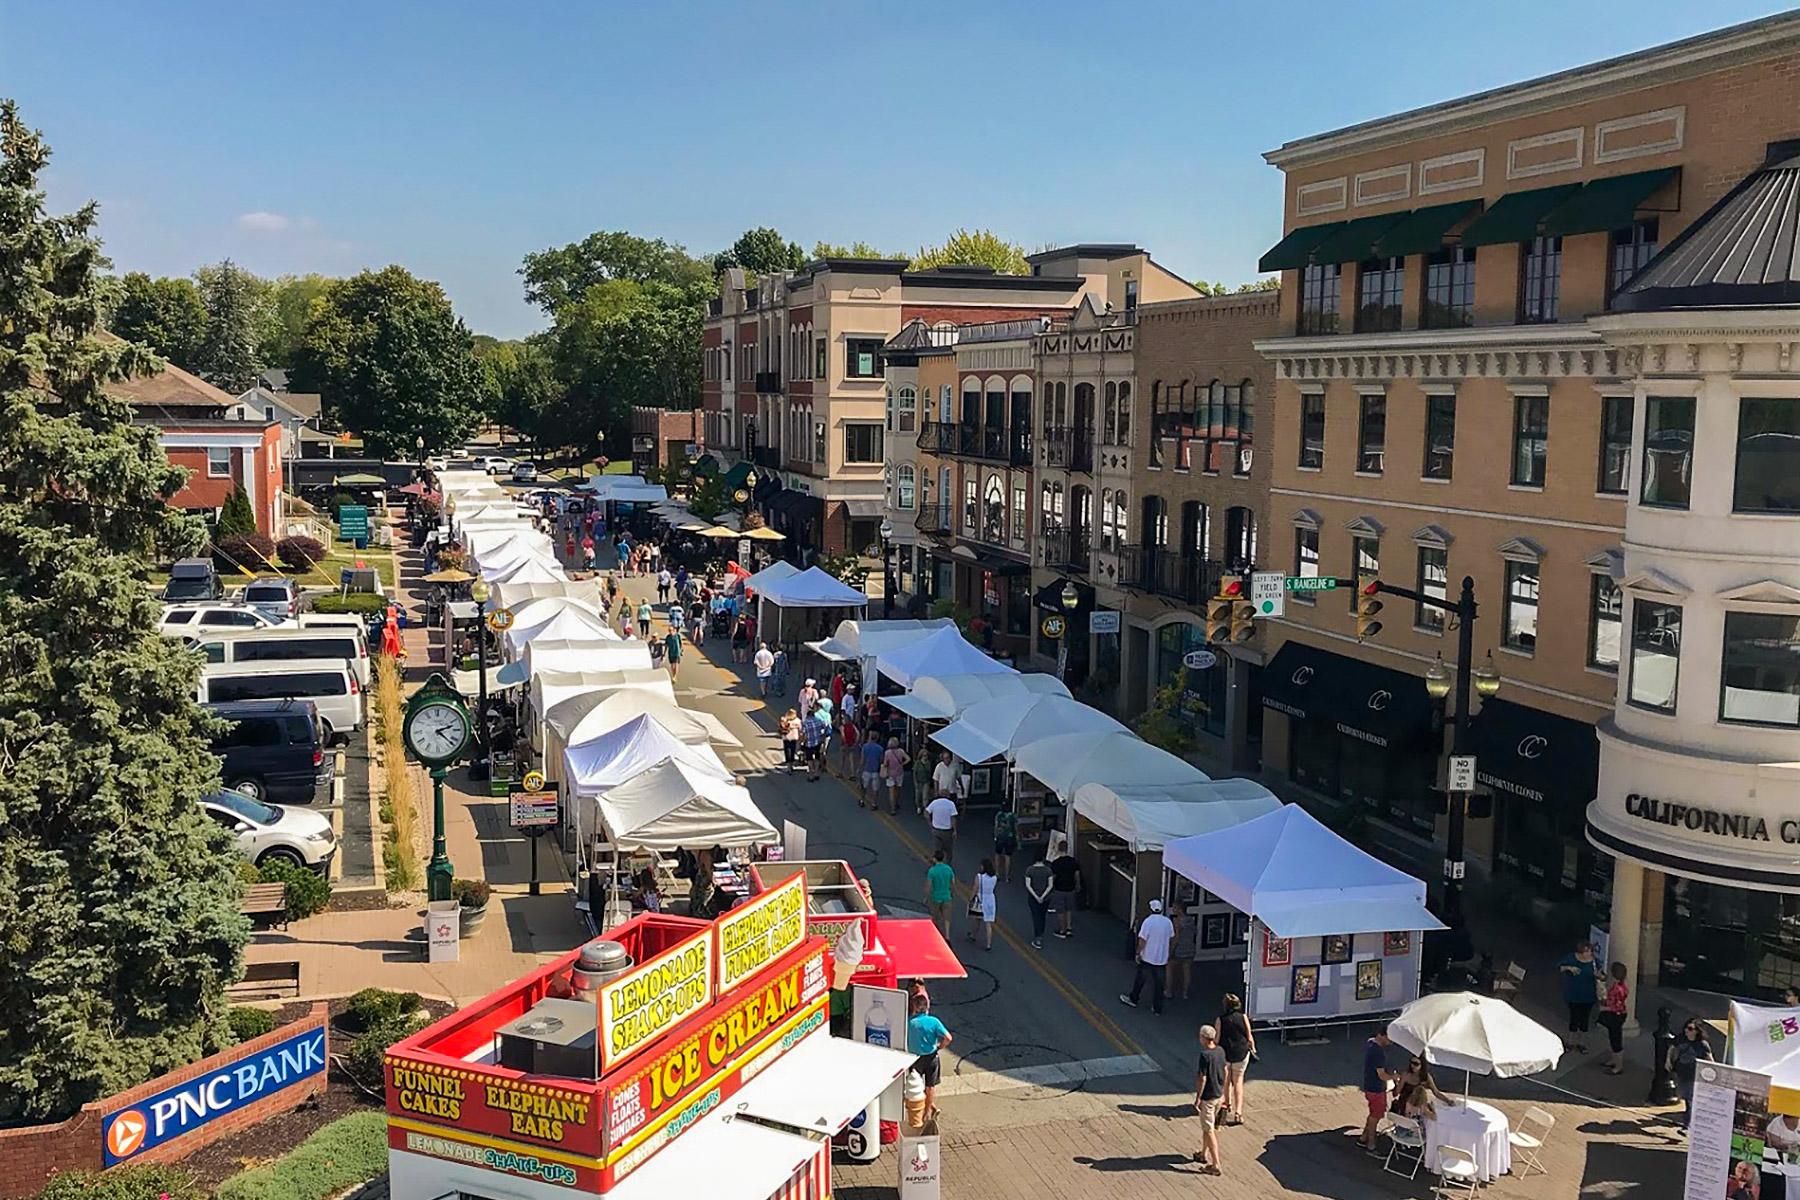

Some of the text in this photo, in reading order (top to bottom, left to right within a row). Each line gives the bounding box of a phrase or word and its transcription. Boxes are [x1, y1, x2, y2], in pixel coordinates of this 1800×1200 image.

[1259, 583, 1278, 592] YIELD
[1286, 579, 1293, 590] S
[1293, 578, 1327, 590] RANGELINE
[1456, 760, 1469, 768] NO
[1477, 771, 1544, 802] CALIFORNIA CLOSETS
[1625, 793, 1771, 842] CALIFORNIA
[722, 898, 779, 956] ELEPHANT
[725, 934, 771, 984] FUNNEL
[610, 940, 706, 1023] LEMONADE
[611, 972, 707, 1057] SHAKE-UPS
[650, 1036, 703, 1112] ICE
[707, 971, 800, 1068] CREAM
[150, 1033, 325, 1137] PNC BANK
[393, 1067, 466, 1100] FUNNEL
[613, 1081, 641, 1111] CONES
[399, 1089, 461, 1121] CAKES
[486, 1085, 589, 1125] ELEPHANT
[611, 1096, 641, 1128] FLOATS
[511, 1112, 564, 1142] EARS
[609, 1108, 646, 1145] SUNDAES
[848, 1133, 862, 1154] G
[483, 1149, 577, 1186] SHAKE-UPS
